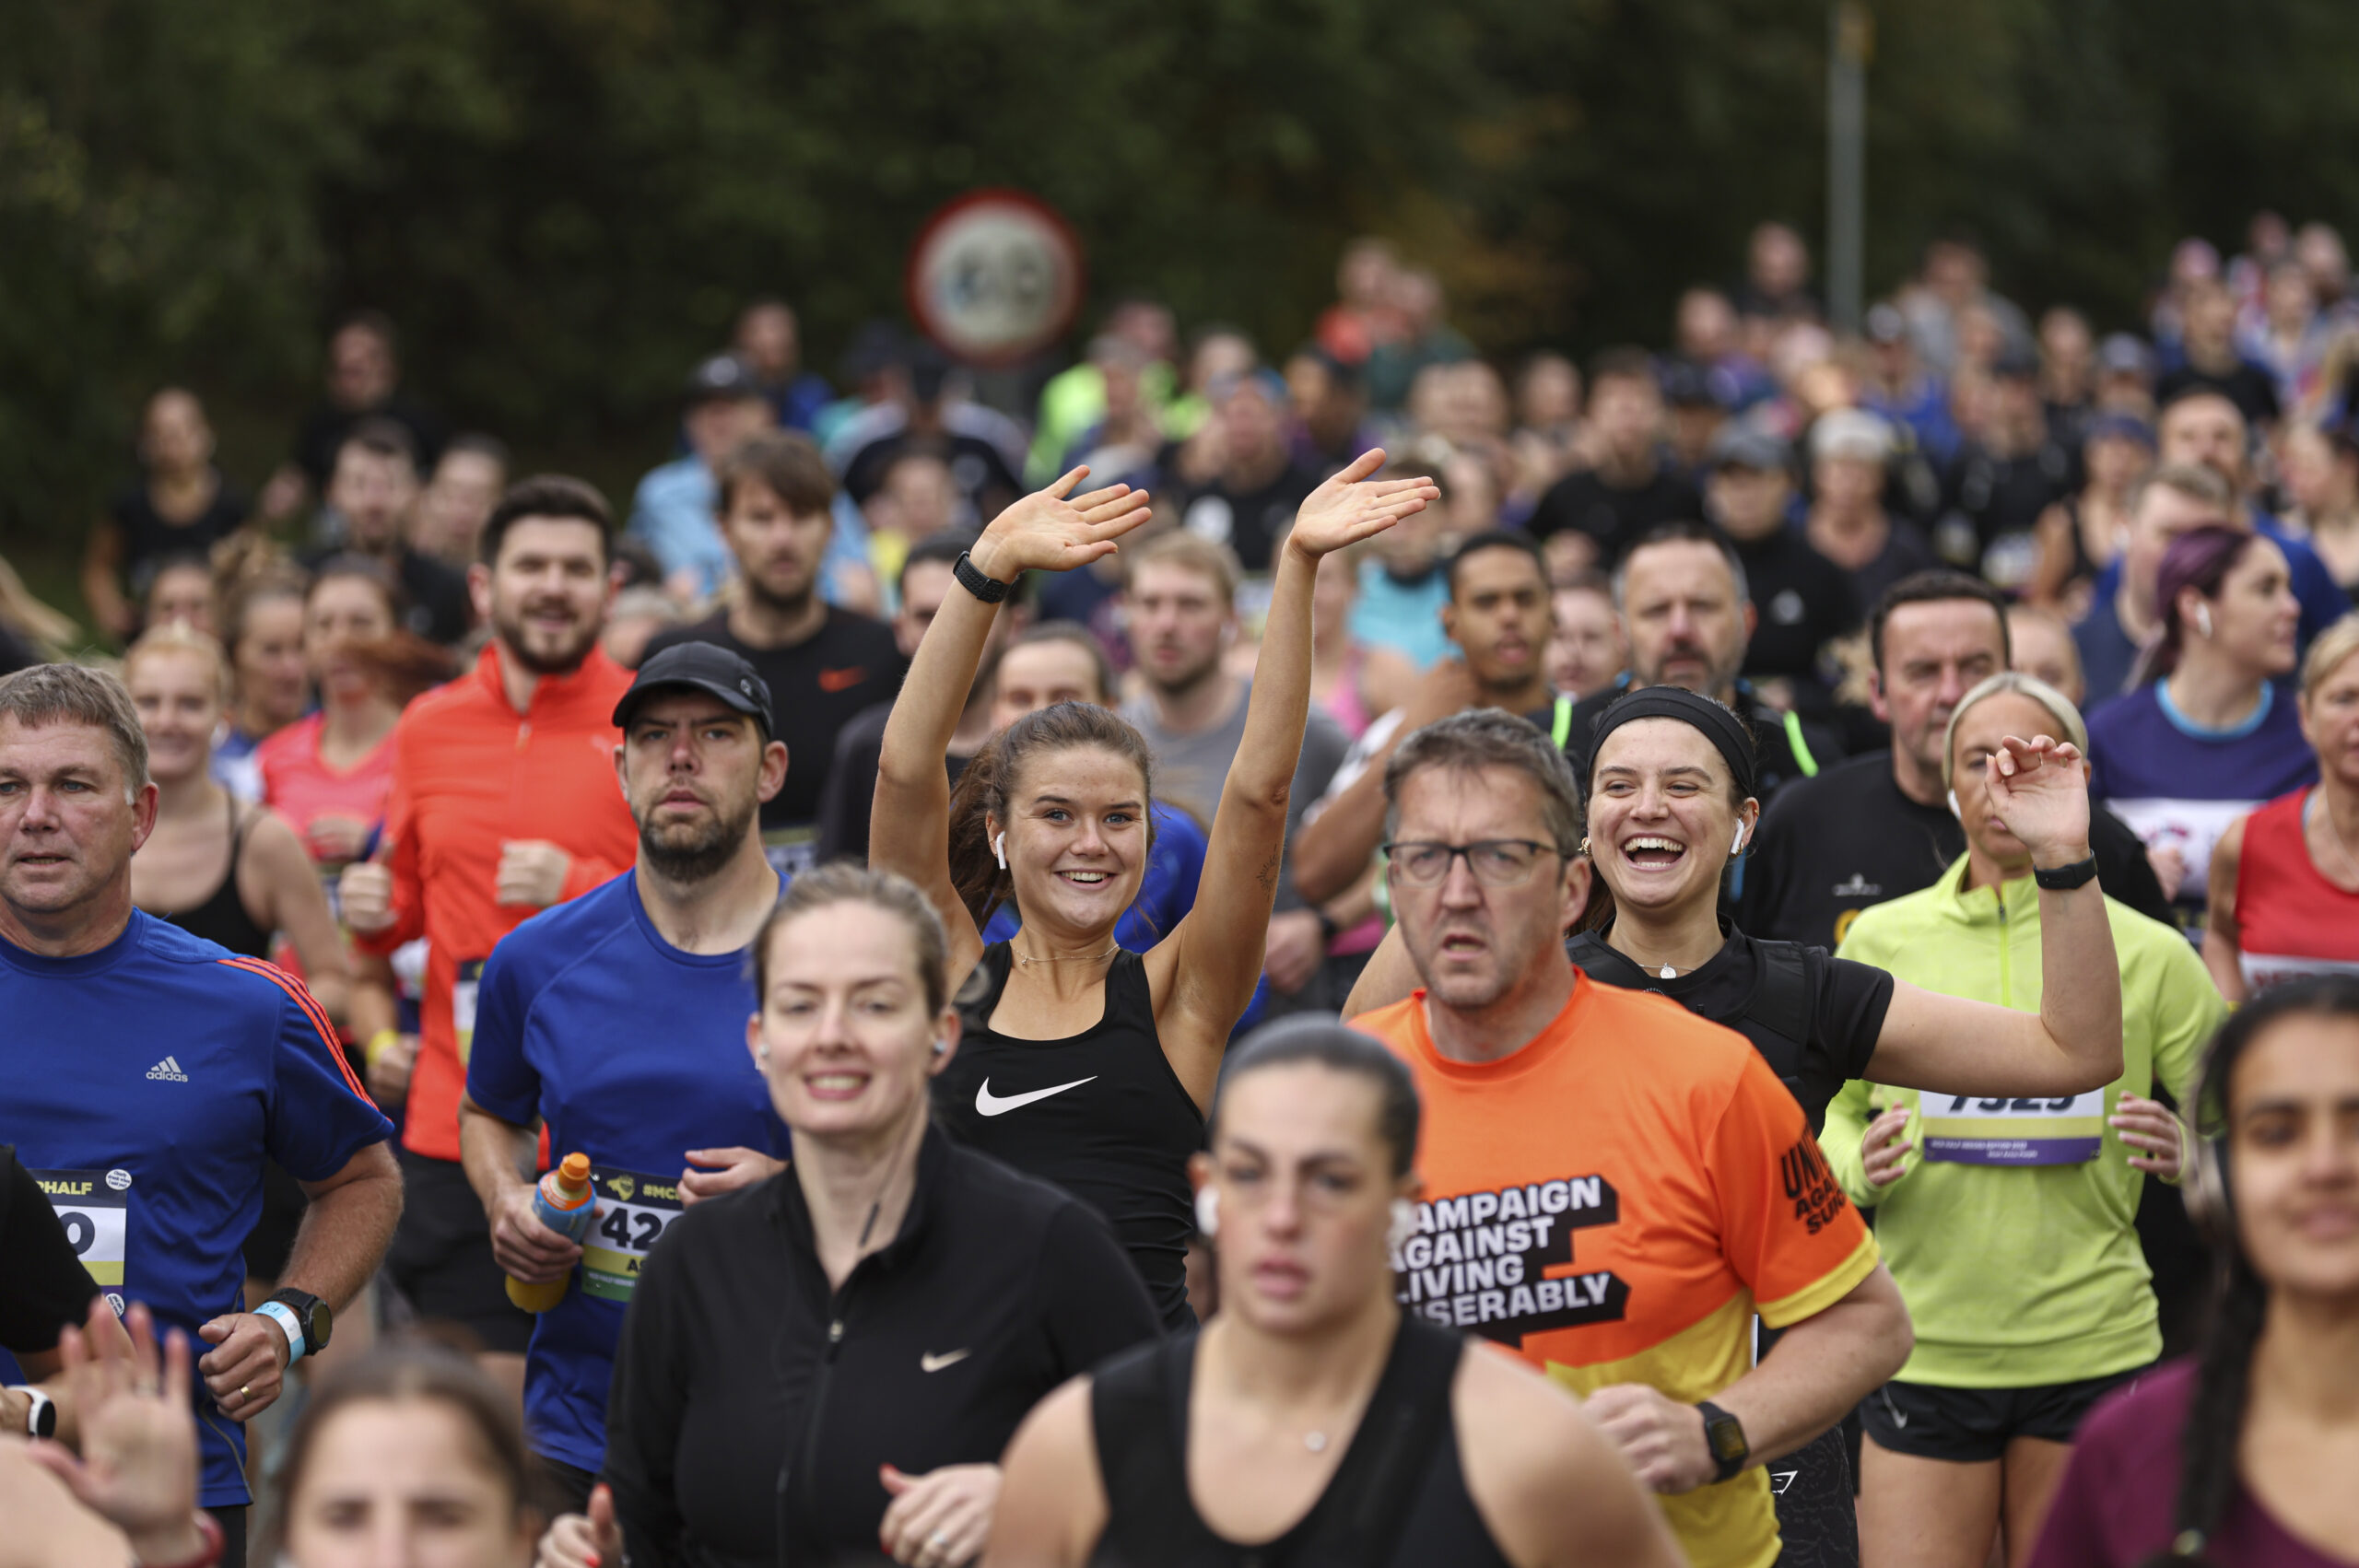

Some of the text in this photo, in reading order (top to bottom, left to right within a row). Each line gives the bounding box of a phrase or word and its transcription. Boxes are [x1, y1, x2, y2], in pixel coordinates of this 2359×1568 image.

[146, 1071, 188, 1082] adidas
[1412, 1175, 1602, 1234] AMPAIGN
[1398, 1254, 1524, 1304] IVING
[1414, 1271, 1612, 1328] SERABLY
